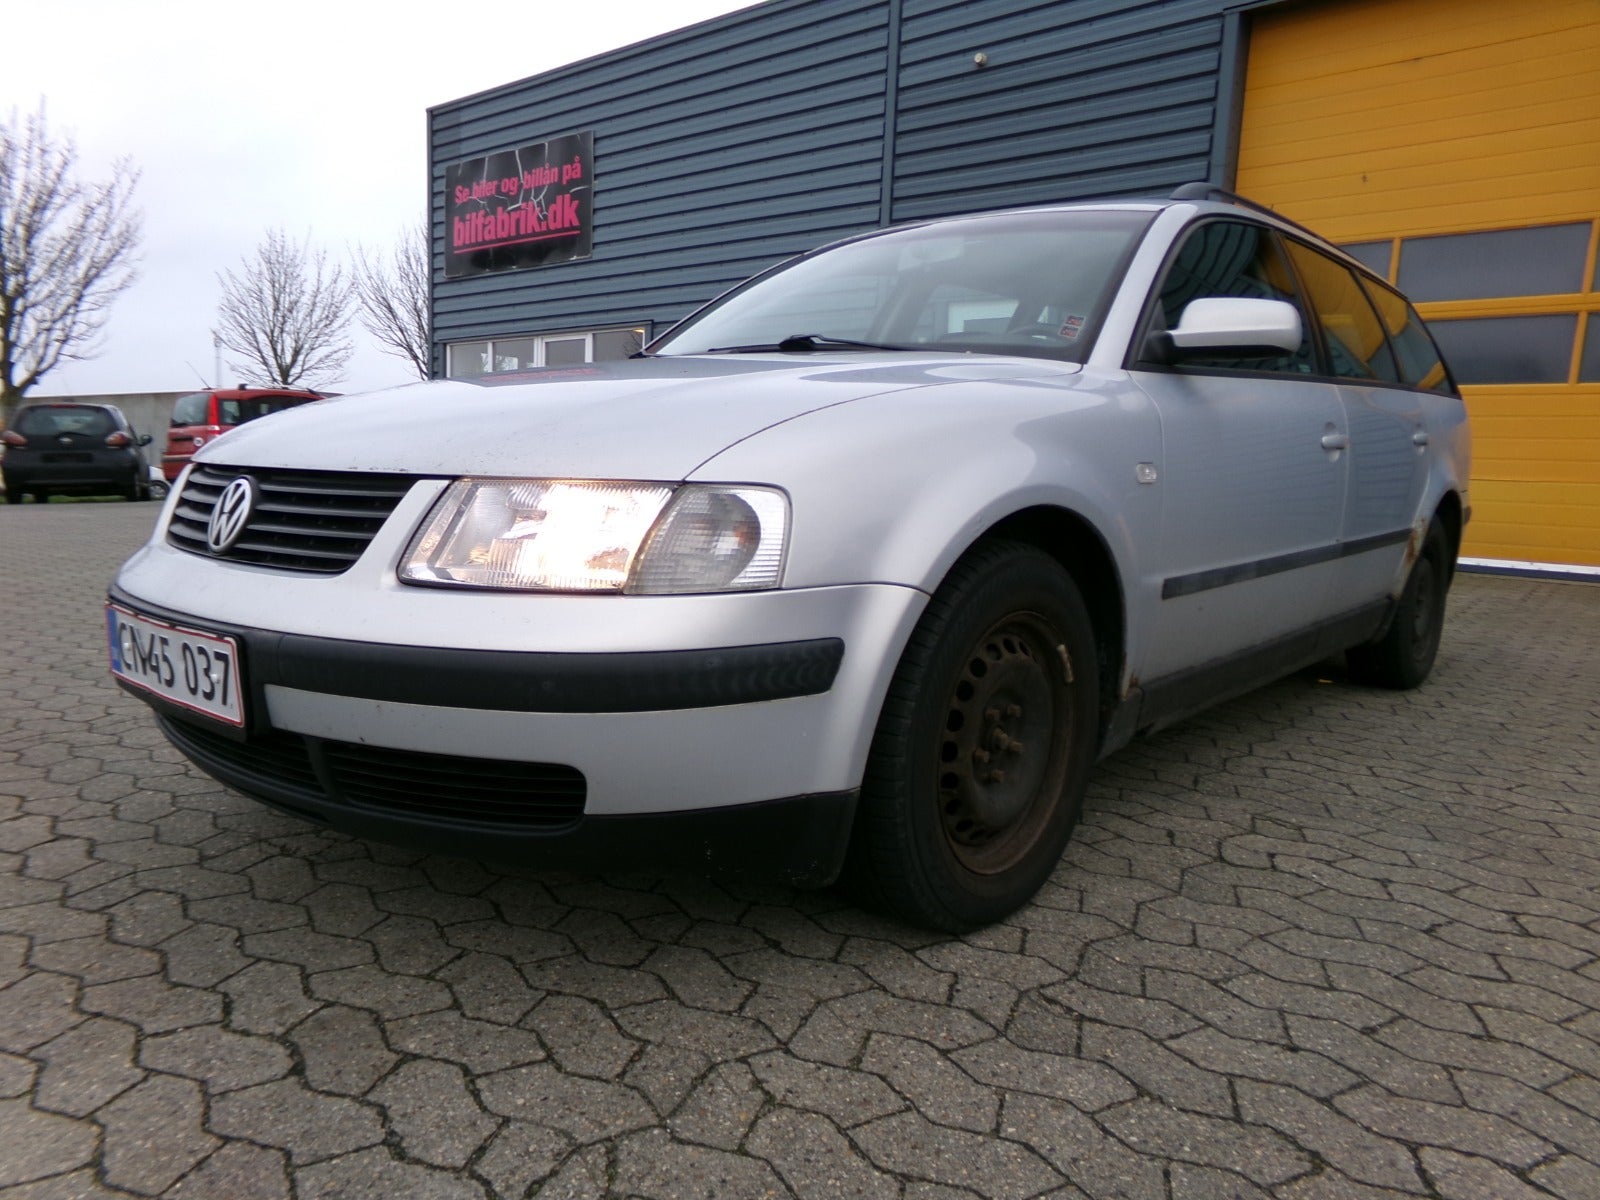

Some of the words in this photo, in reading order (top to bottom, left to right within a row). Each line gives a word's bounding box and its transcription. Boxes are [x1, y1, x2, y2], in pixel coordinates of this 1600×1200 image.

[455, 185, 469, 203] Se
[501, 176, 518, 195] og
[523, 163, 559, 189] billån
[562, 155, 582, 184] på
[453, 194, 580, 246] bilfabrik.dk
